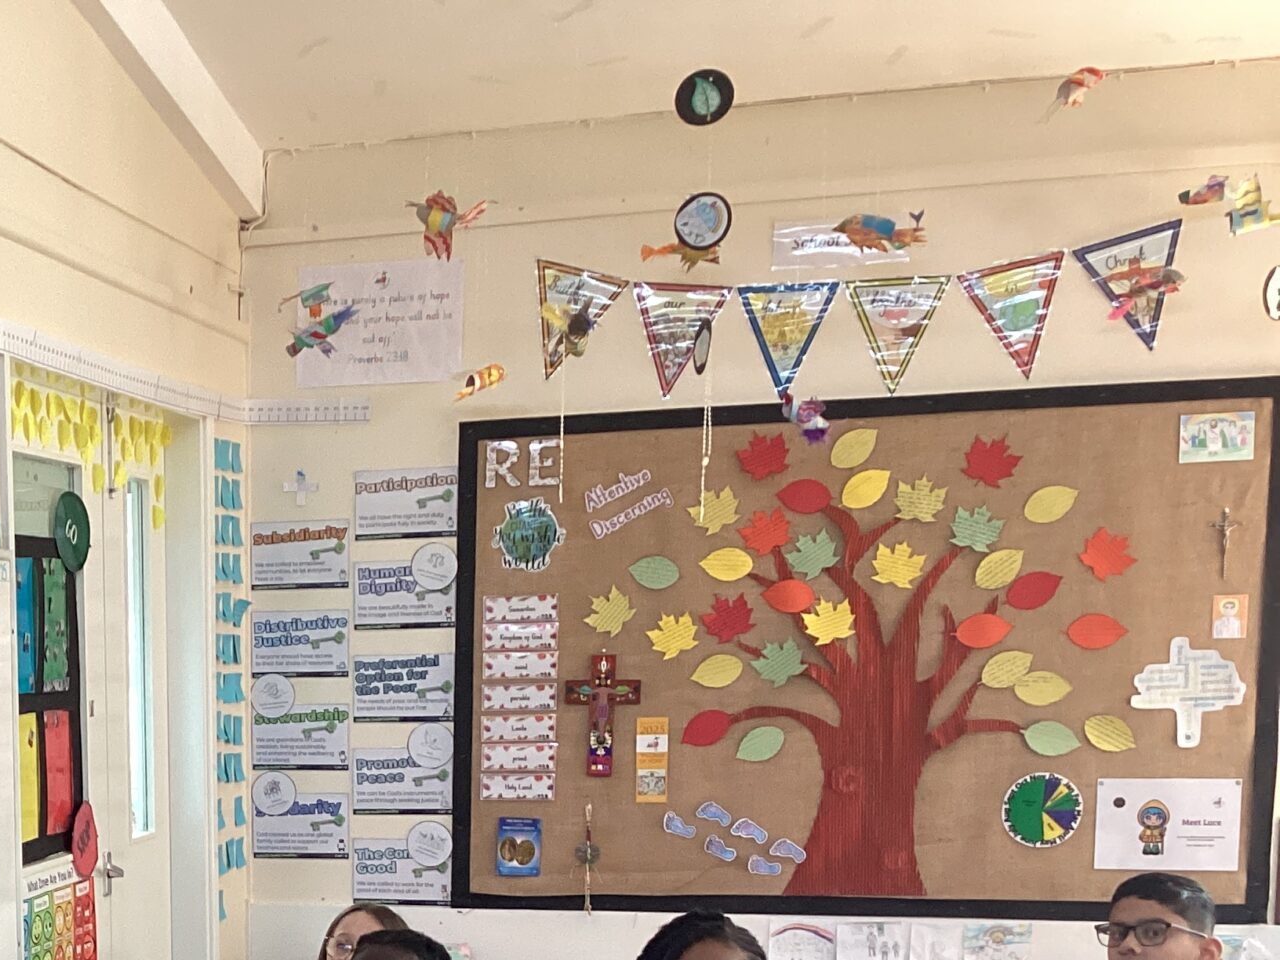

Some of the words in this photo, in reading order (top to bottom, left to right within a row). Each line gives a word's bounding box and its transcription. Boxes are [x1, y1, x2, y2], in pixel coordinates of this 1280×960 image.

[417, 294, 426, 304] of
[430, 289, 450, 304] hope
[385, 312, 405, 326] hope
[425, 309, 440, 320] not
[348, 353, 383, 364] Proverbs
[484, 439, 560, 488] RE
[355, 473, 458, 495] Participation
[586, 470, 650, 511] Attentive
[591, 490, 673, 538] Discerning
[65, 519, 78, 545] GO
[253, 525, 348, 545] Subsidiarity
[358, 578, 418, 596] Dignity
[254, 615, 348, 634] Distributive
[254, 633, 310, 648] Justice
[354, 654, 439, 672] Preferential
[355, 669, 404, 685] Option
[406, 669, 428, 680] for
[355, 685, 380, 696] the
[383, 683, 417, 694] Poor
[510, 693, 530, 703] parable
[356, 756, 422, 771] Promot
[357, 772, 405, 785] Peace
[504, 783, 517, 792] Holy
[355, 848, 383, 861] The
[356, 861, 397, 874] Good
[27, 878, 38, 892] What
[39, 876, 49, 890] Zone
[49, 874, 57, 884] Are
[57, 870, 67, 882] You
